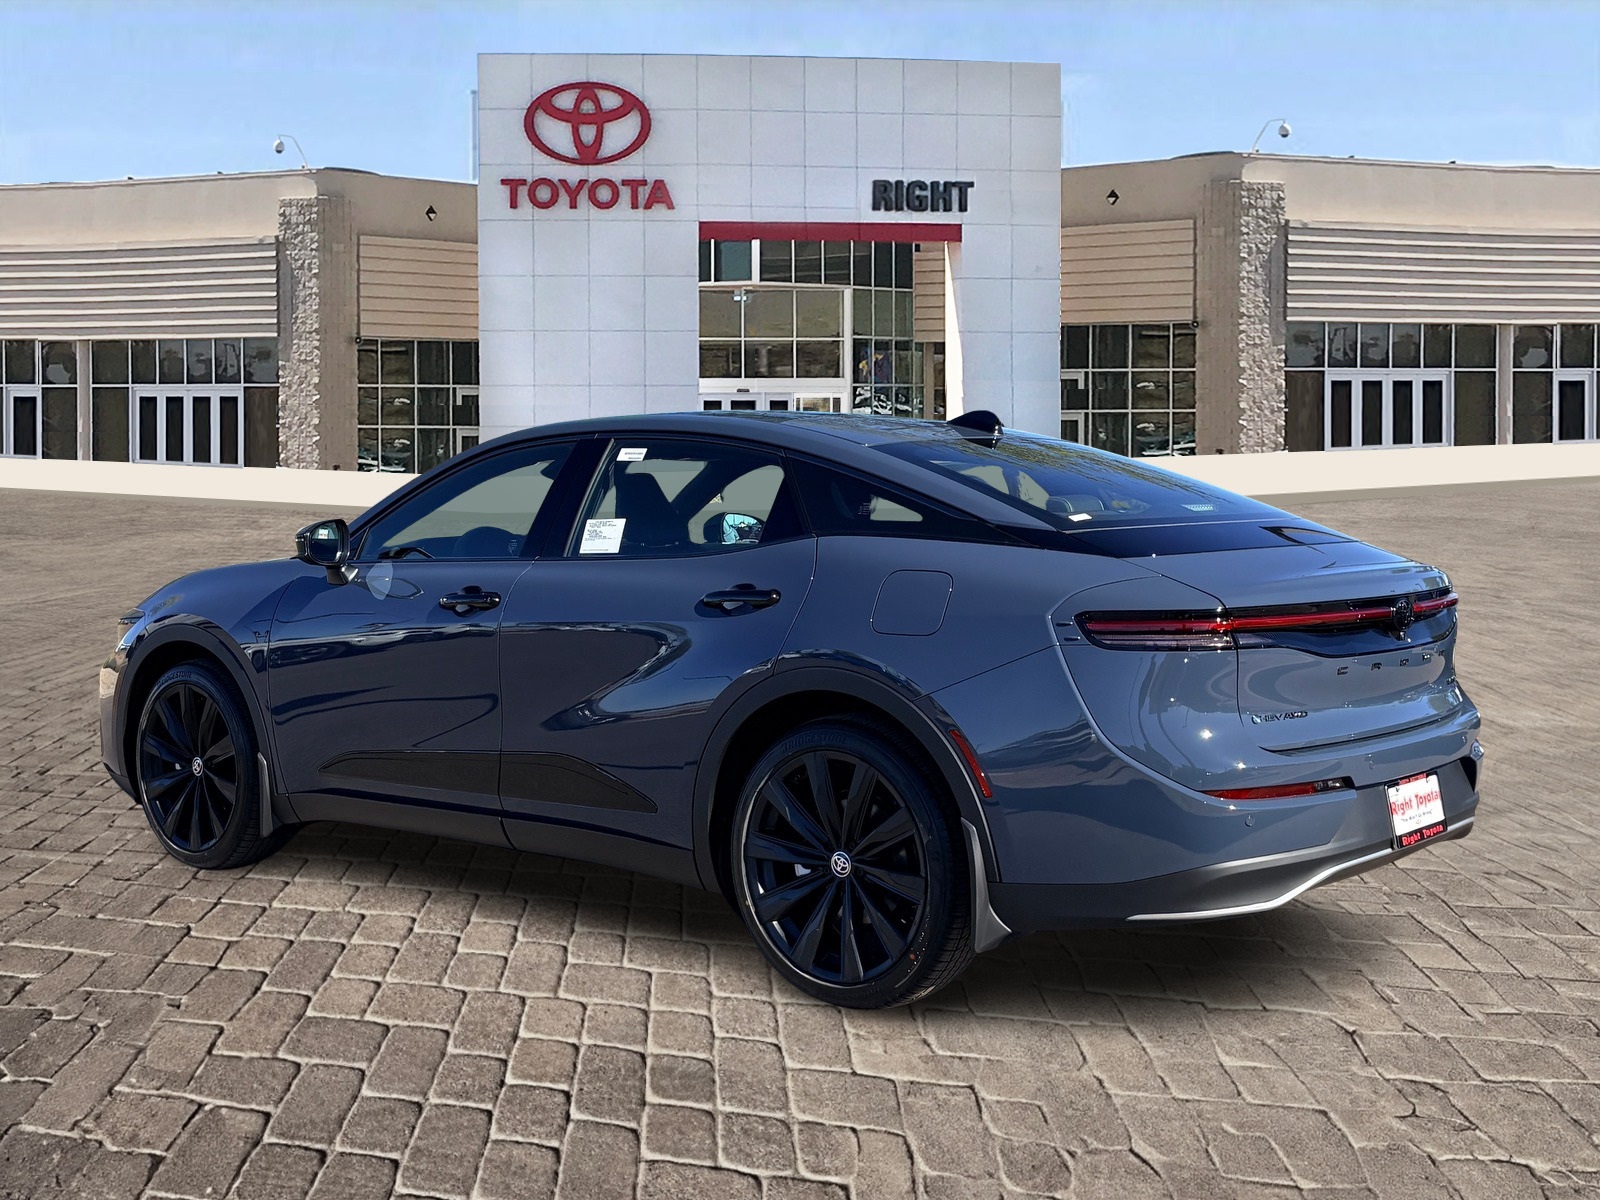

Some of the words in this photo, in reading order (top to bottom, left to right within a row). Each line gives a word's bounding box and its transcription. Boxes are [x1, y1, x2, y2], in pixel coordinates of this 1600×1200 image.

[501, 177, 675, 210] TOYOTA
[872, 179, 975, 212] RIGHT
[1390, 795, 1413, 816] Right
[1415, 790, 1441, 809] Toyota
[1402, 833, 1421, 846] Right
[1422, 824, 1444, 838] Toyota
